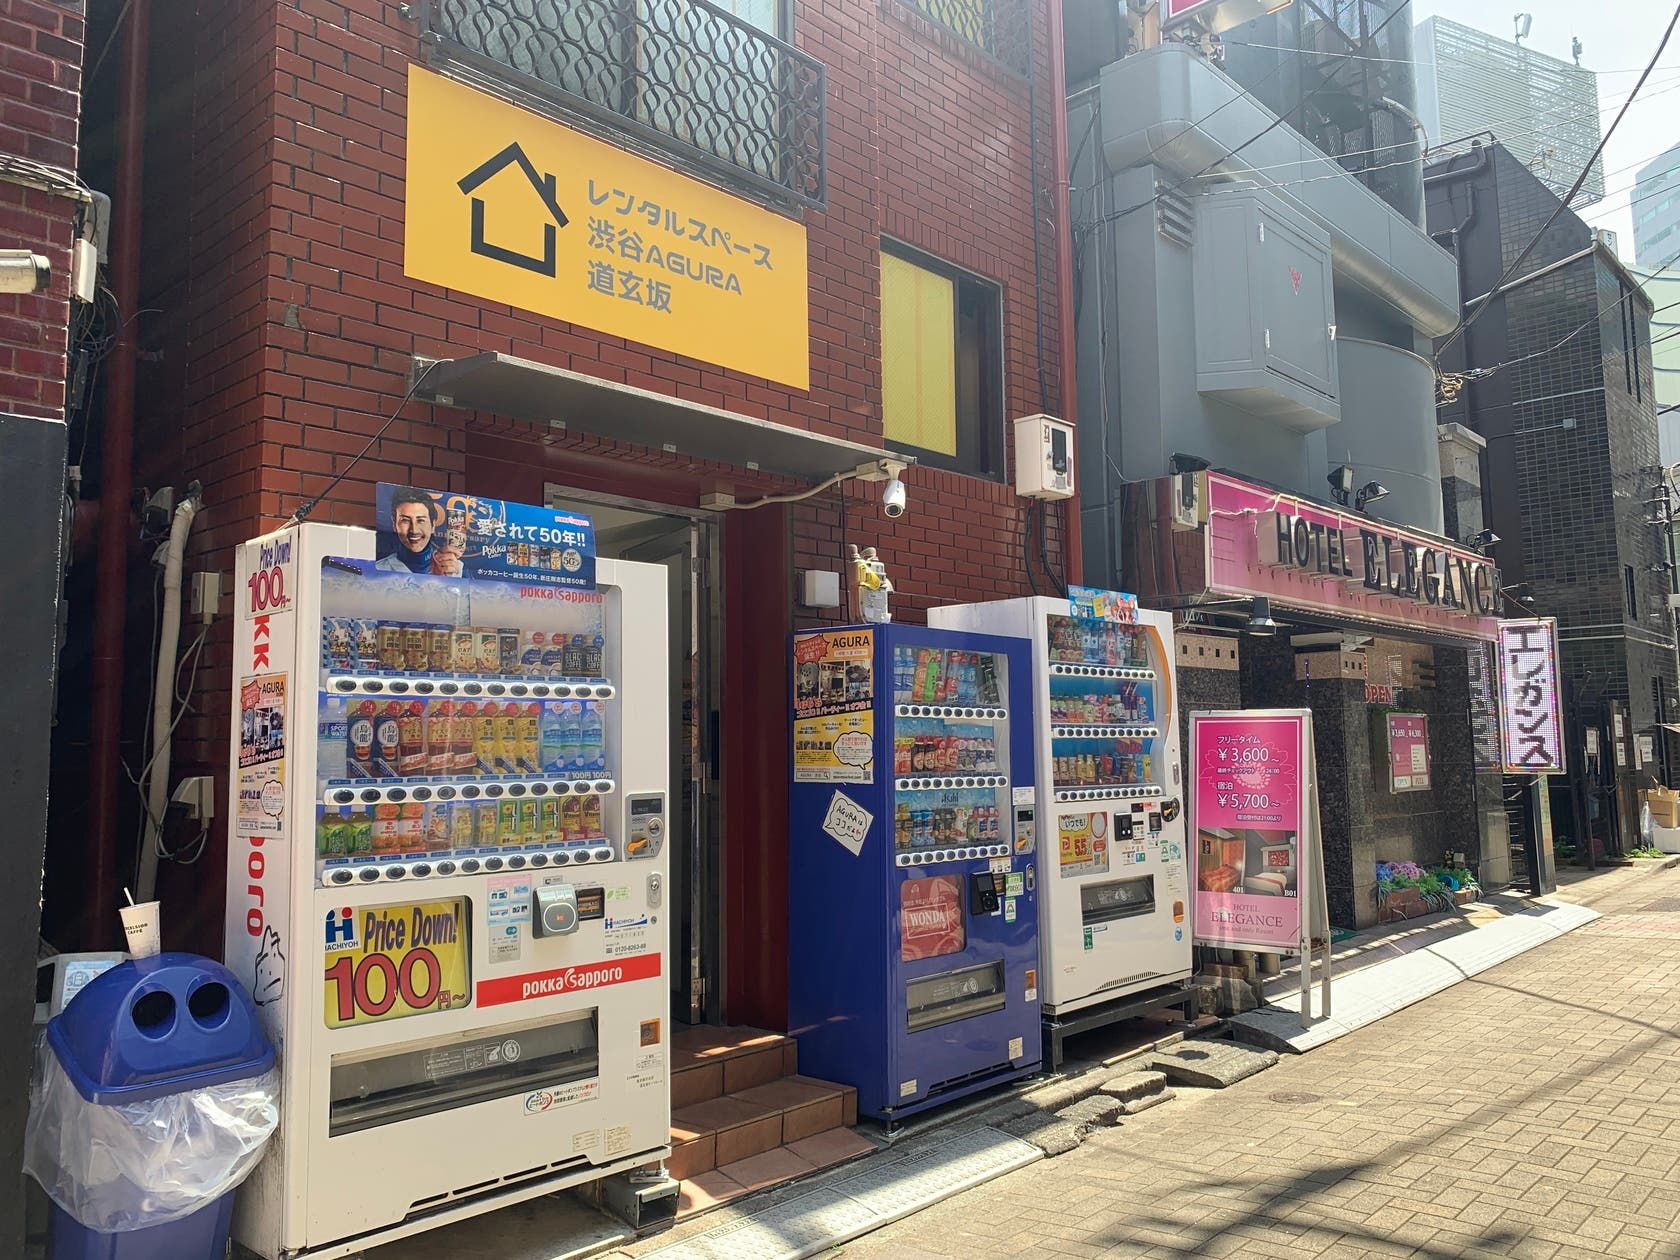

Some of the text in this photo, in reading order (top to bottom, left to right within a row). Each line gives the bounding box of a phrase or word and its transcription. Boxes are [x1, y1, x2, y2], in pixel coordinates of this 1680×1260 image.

[587, 179, 774, 271] レンタルスペース
[586, 215, 743, 296] 渋谷AGURA
[586, 260, 673, 315] 道玄坂
[260, 535, 292, 570] Price Down!
[482, 545, 507, 556] Pokka
[1276, 510, 1505, 619] HOTEL ELEGANCE
[831, 635, 870, 648] AGURA
[262, 681, 285, 695] AGURA
[1508, 626, 1554, 764] エレガンス
[1217, 736, 1261, 744] フリータイム
[1217, 781, 1233, 790] 宿泊
[1232, 886, 1244, 894] 401
[1284, 889, 1296, 897] B01
[1233, 903, 1260, 912] HOTEL
[909, 910, 946, 926] WONDA
[1211, 911, 1283, 928] ELEGANCE
[363, 910, 406, 953] Price
[410, 903, 460, 948] Down!
